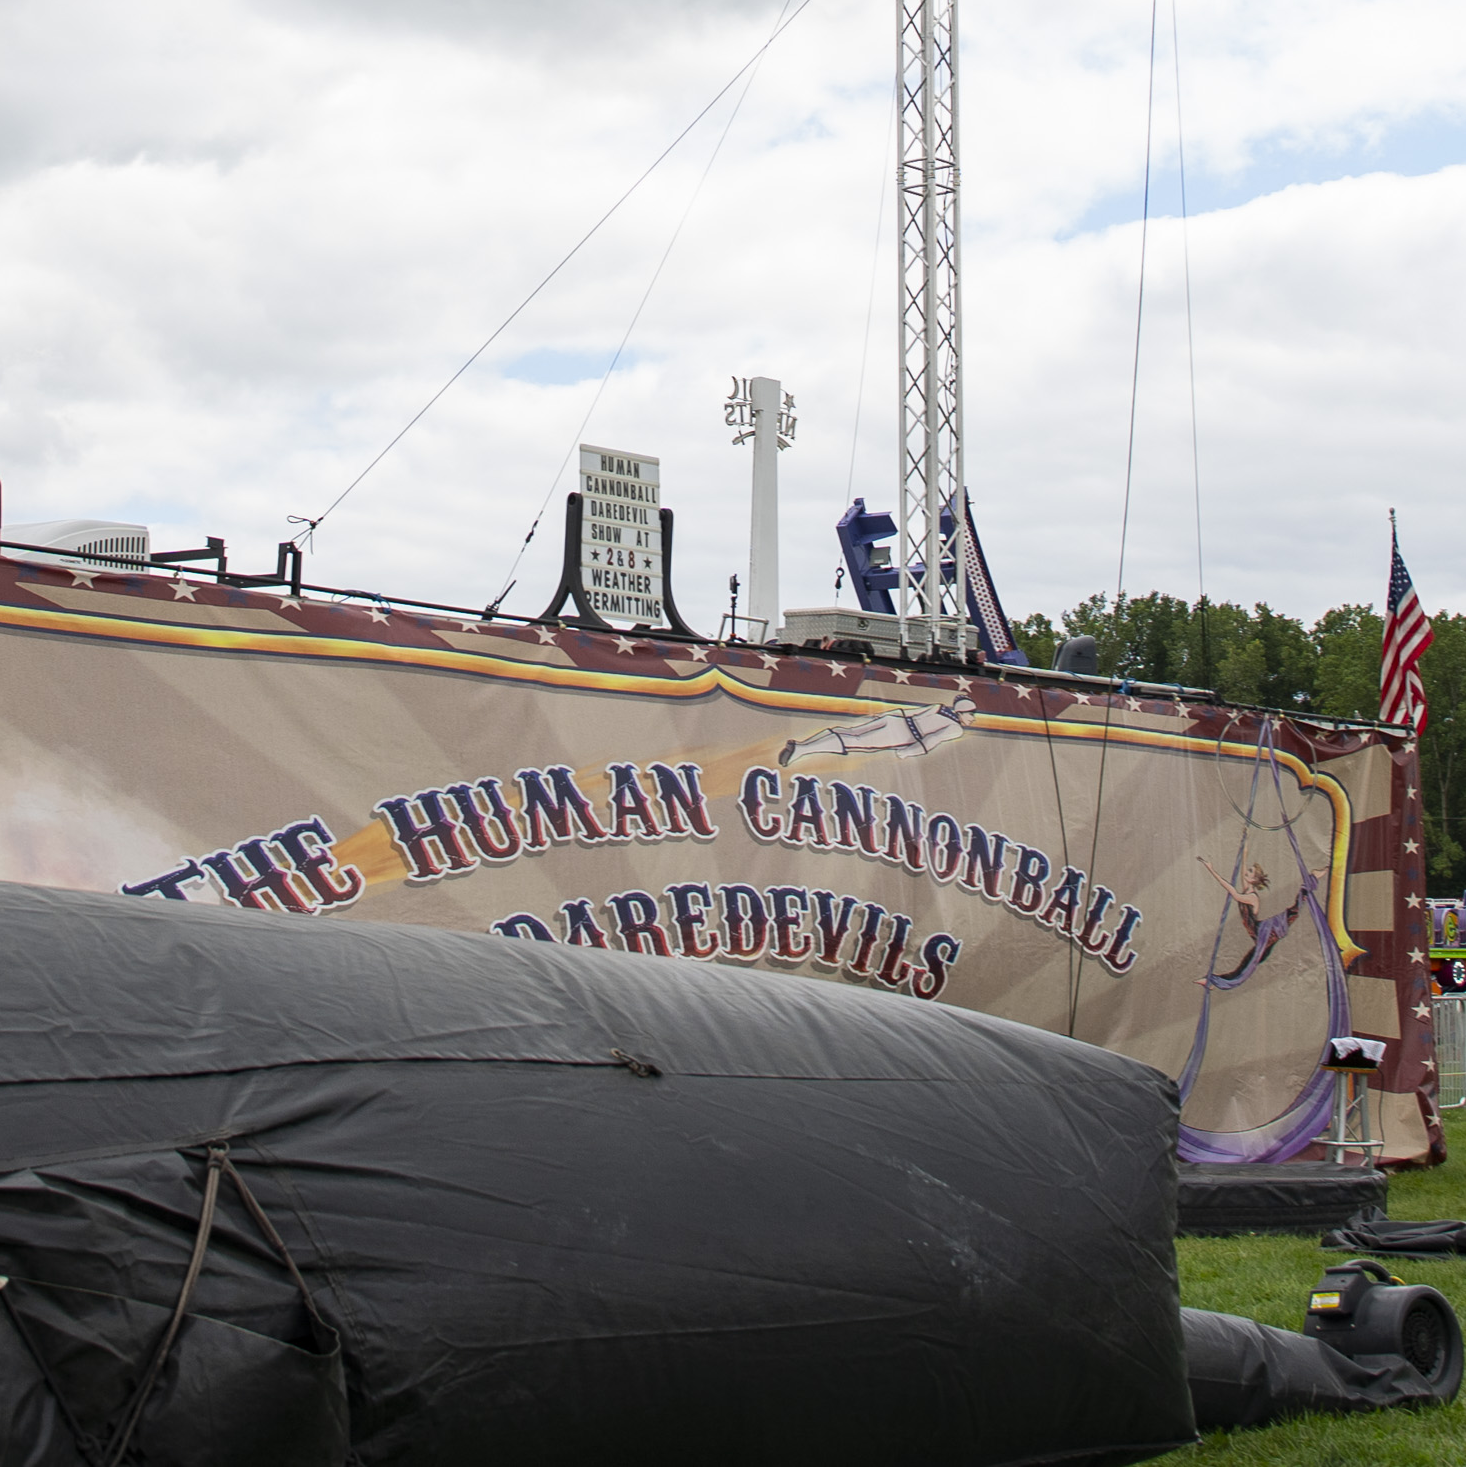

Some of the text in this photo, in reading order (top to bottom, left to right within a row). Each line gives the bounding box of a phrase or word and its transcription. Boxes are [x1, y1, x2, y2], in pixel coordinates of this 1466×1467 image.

[601, 455, 640, 479] HUMAN
[586, 476, 657, 504] CANNONBALL
[591, 500, 648, 525] DAREDEVIL
[591, 524, 650, 548] SHOW AT
[607, 548, 635, 569] 2 & 8
[592, 569, 651, 595] WEATHER
[585, 590, 661, 619] PERMITTING
[375, 762, 720, 883] HUMAN
[737, 766, 1143, 974] CANNONBALL
